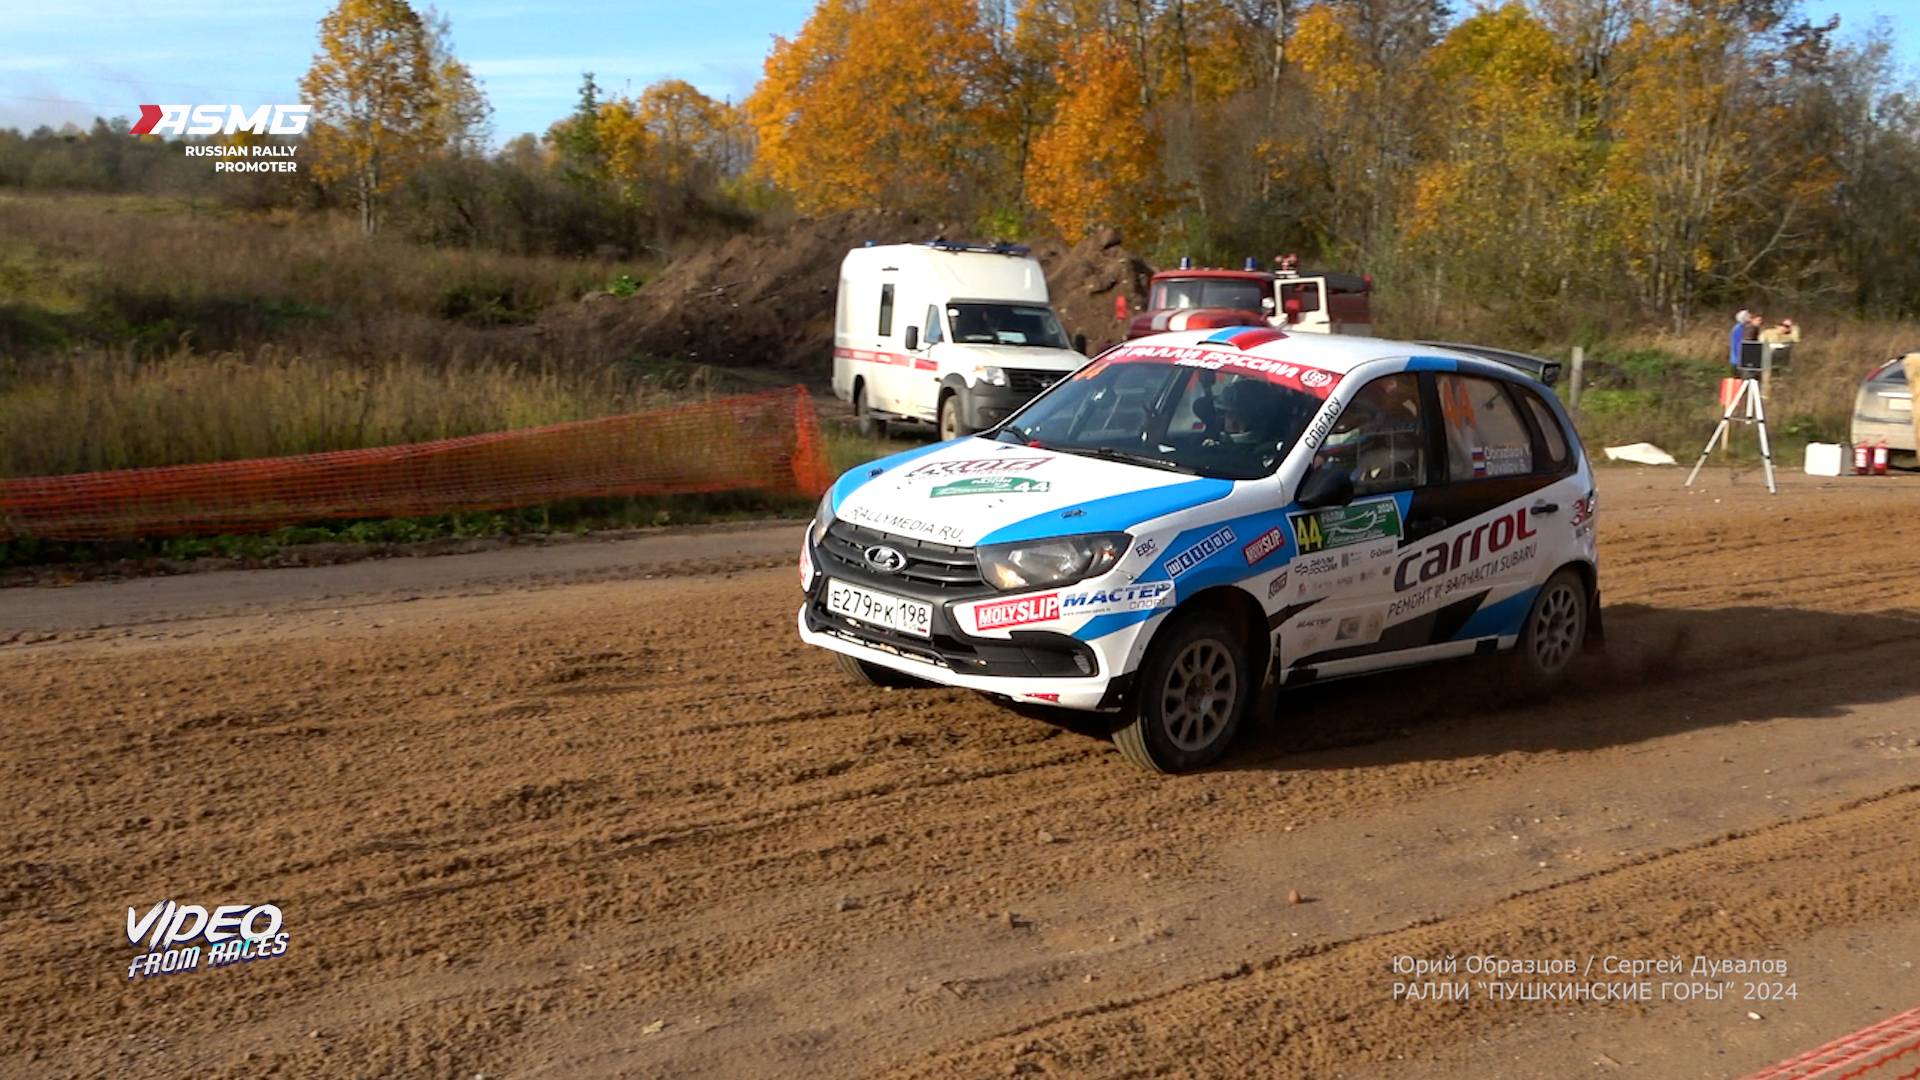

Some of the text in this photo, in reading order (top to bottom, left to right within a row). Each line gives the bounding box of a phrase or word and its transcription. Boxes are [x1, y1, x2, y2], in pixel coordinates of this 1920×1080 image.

[1208, 350, 1300, 378] РОССИИ
[1013, 481, 1049, 493] 44
[1297, 514, 1323, 552] 44
[1135, 538, 1156, 558] EBC
[1387, 586, 1433, 618] РЕМОНТ
[1444, 560, 1499, 595] ЗАПЧАСТИ
[1500, 544, 1537, 572] SUBARU
[1063, 582, 1172, 608] МАСТЕР
[899, 602, 928, 625] 198
[977, 597, 1058, 626] MOLYSLIP
